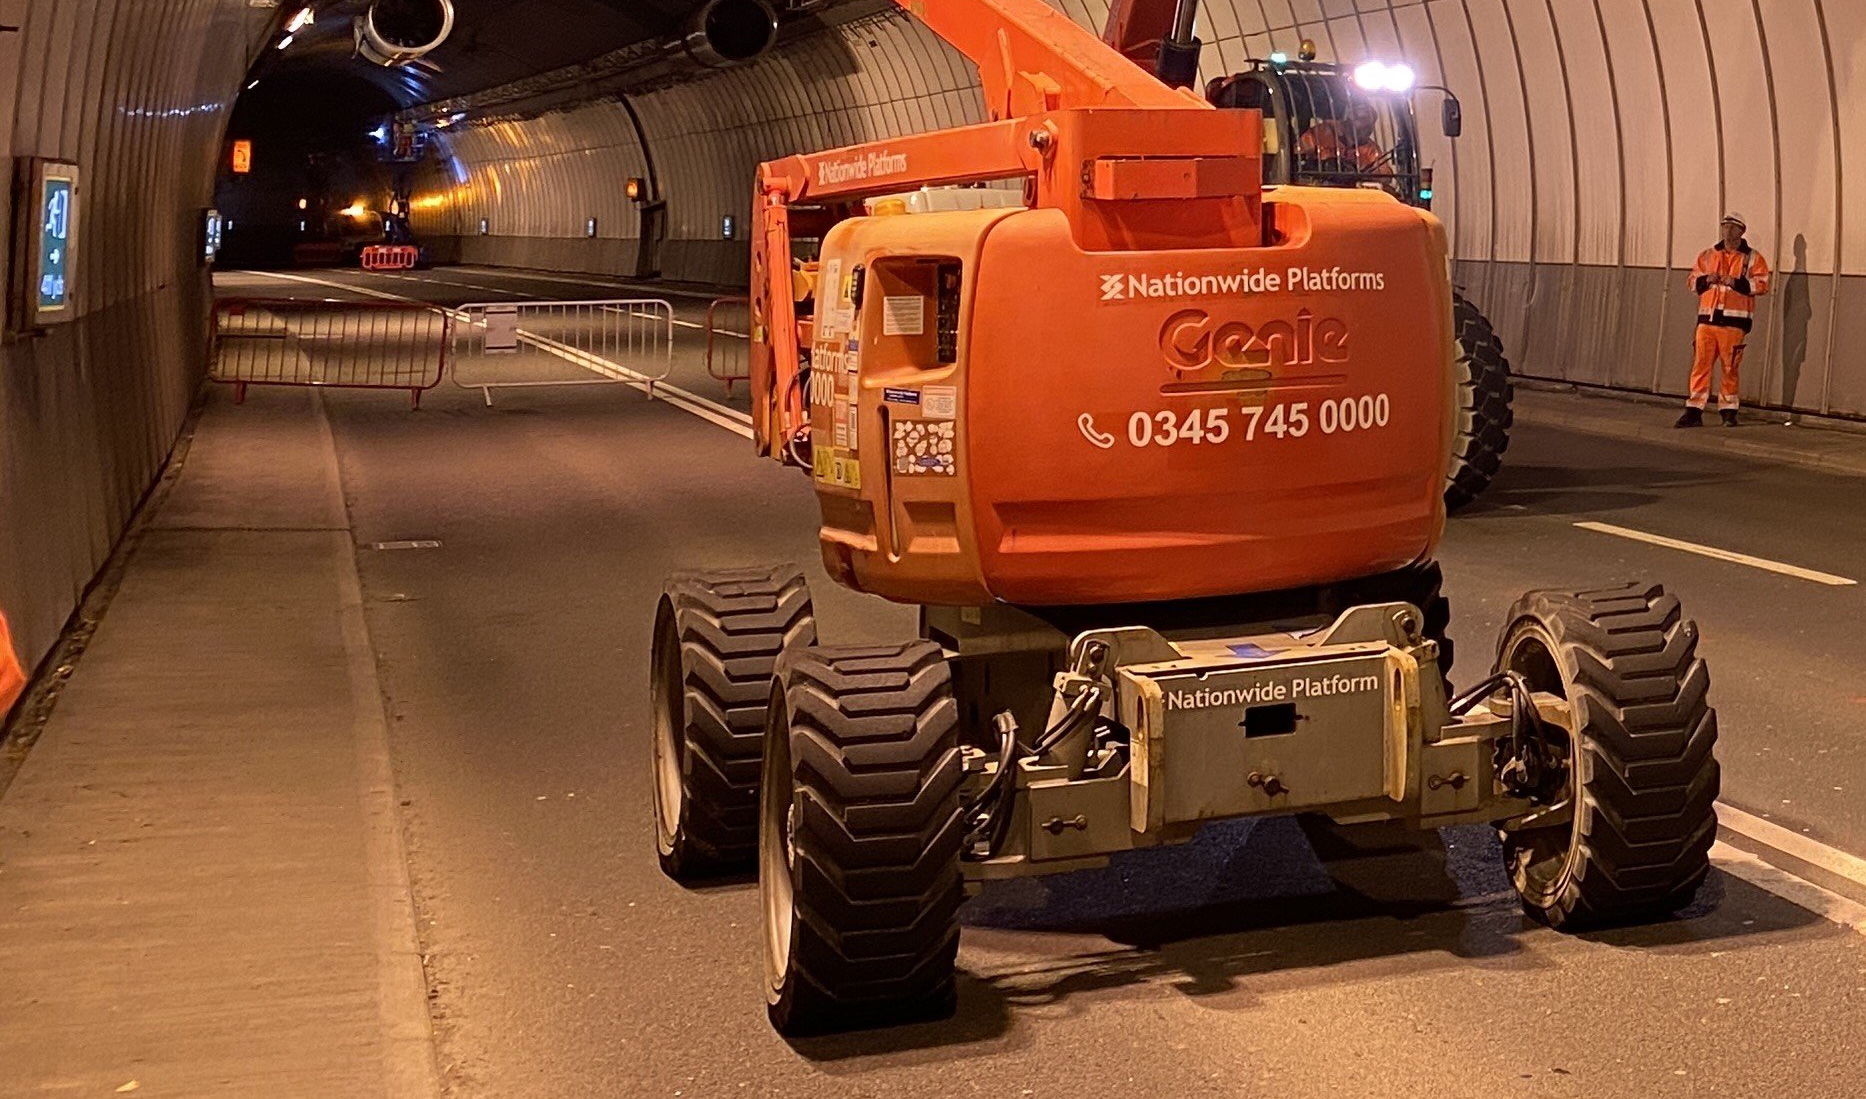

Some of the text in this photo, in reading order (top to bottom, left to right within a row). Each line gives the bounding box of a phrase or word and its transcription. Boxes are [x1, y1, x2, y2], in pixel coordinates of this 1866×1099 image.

[824, 150, 907, 184] Nationwide Platforms
[1128, 267, 1384, 298] Nationwide Platforms
[1158, 307, 1348, 371] Genie
[1128, 393, 1390, 447] 0345 745 0000
[1168, 674, 1378, 711] Nationwide Platform
